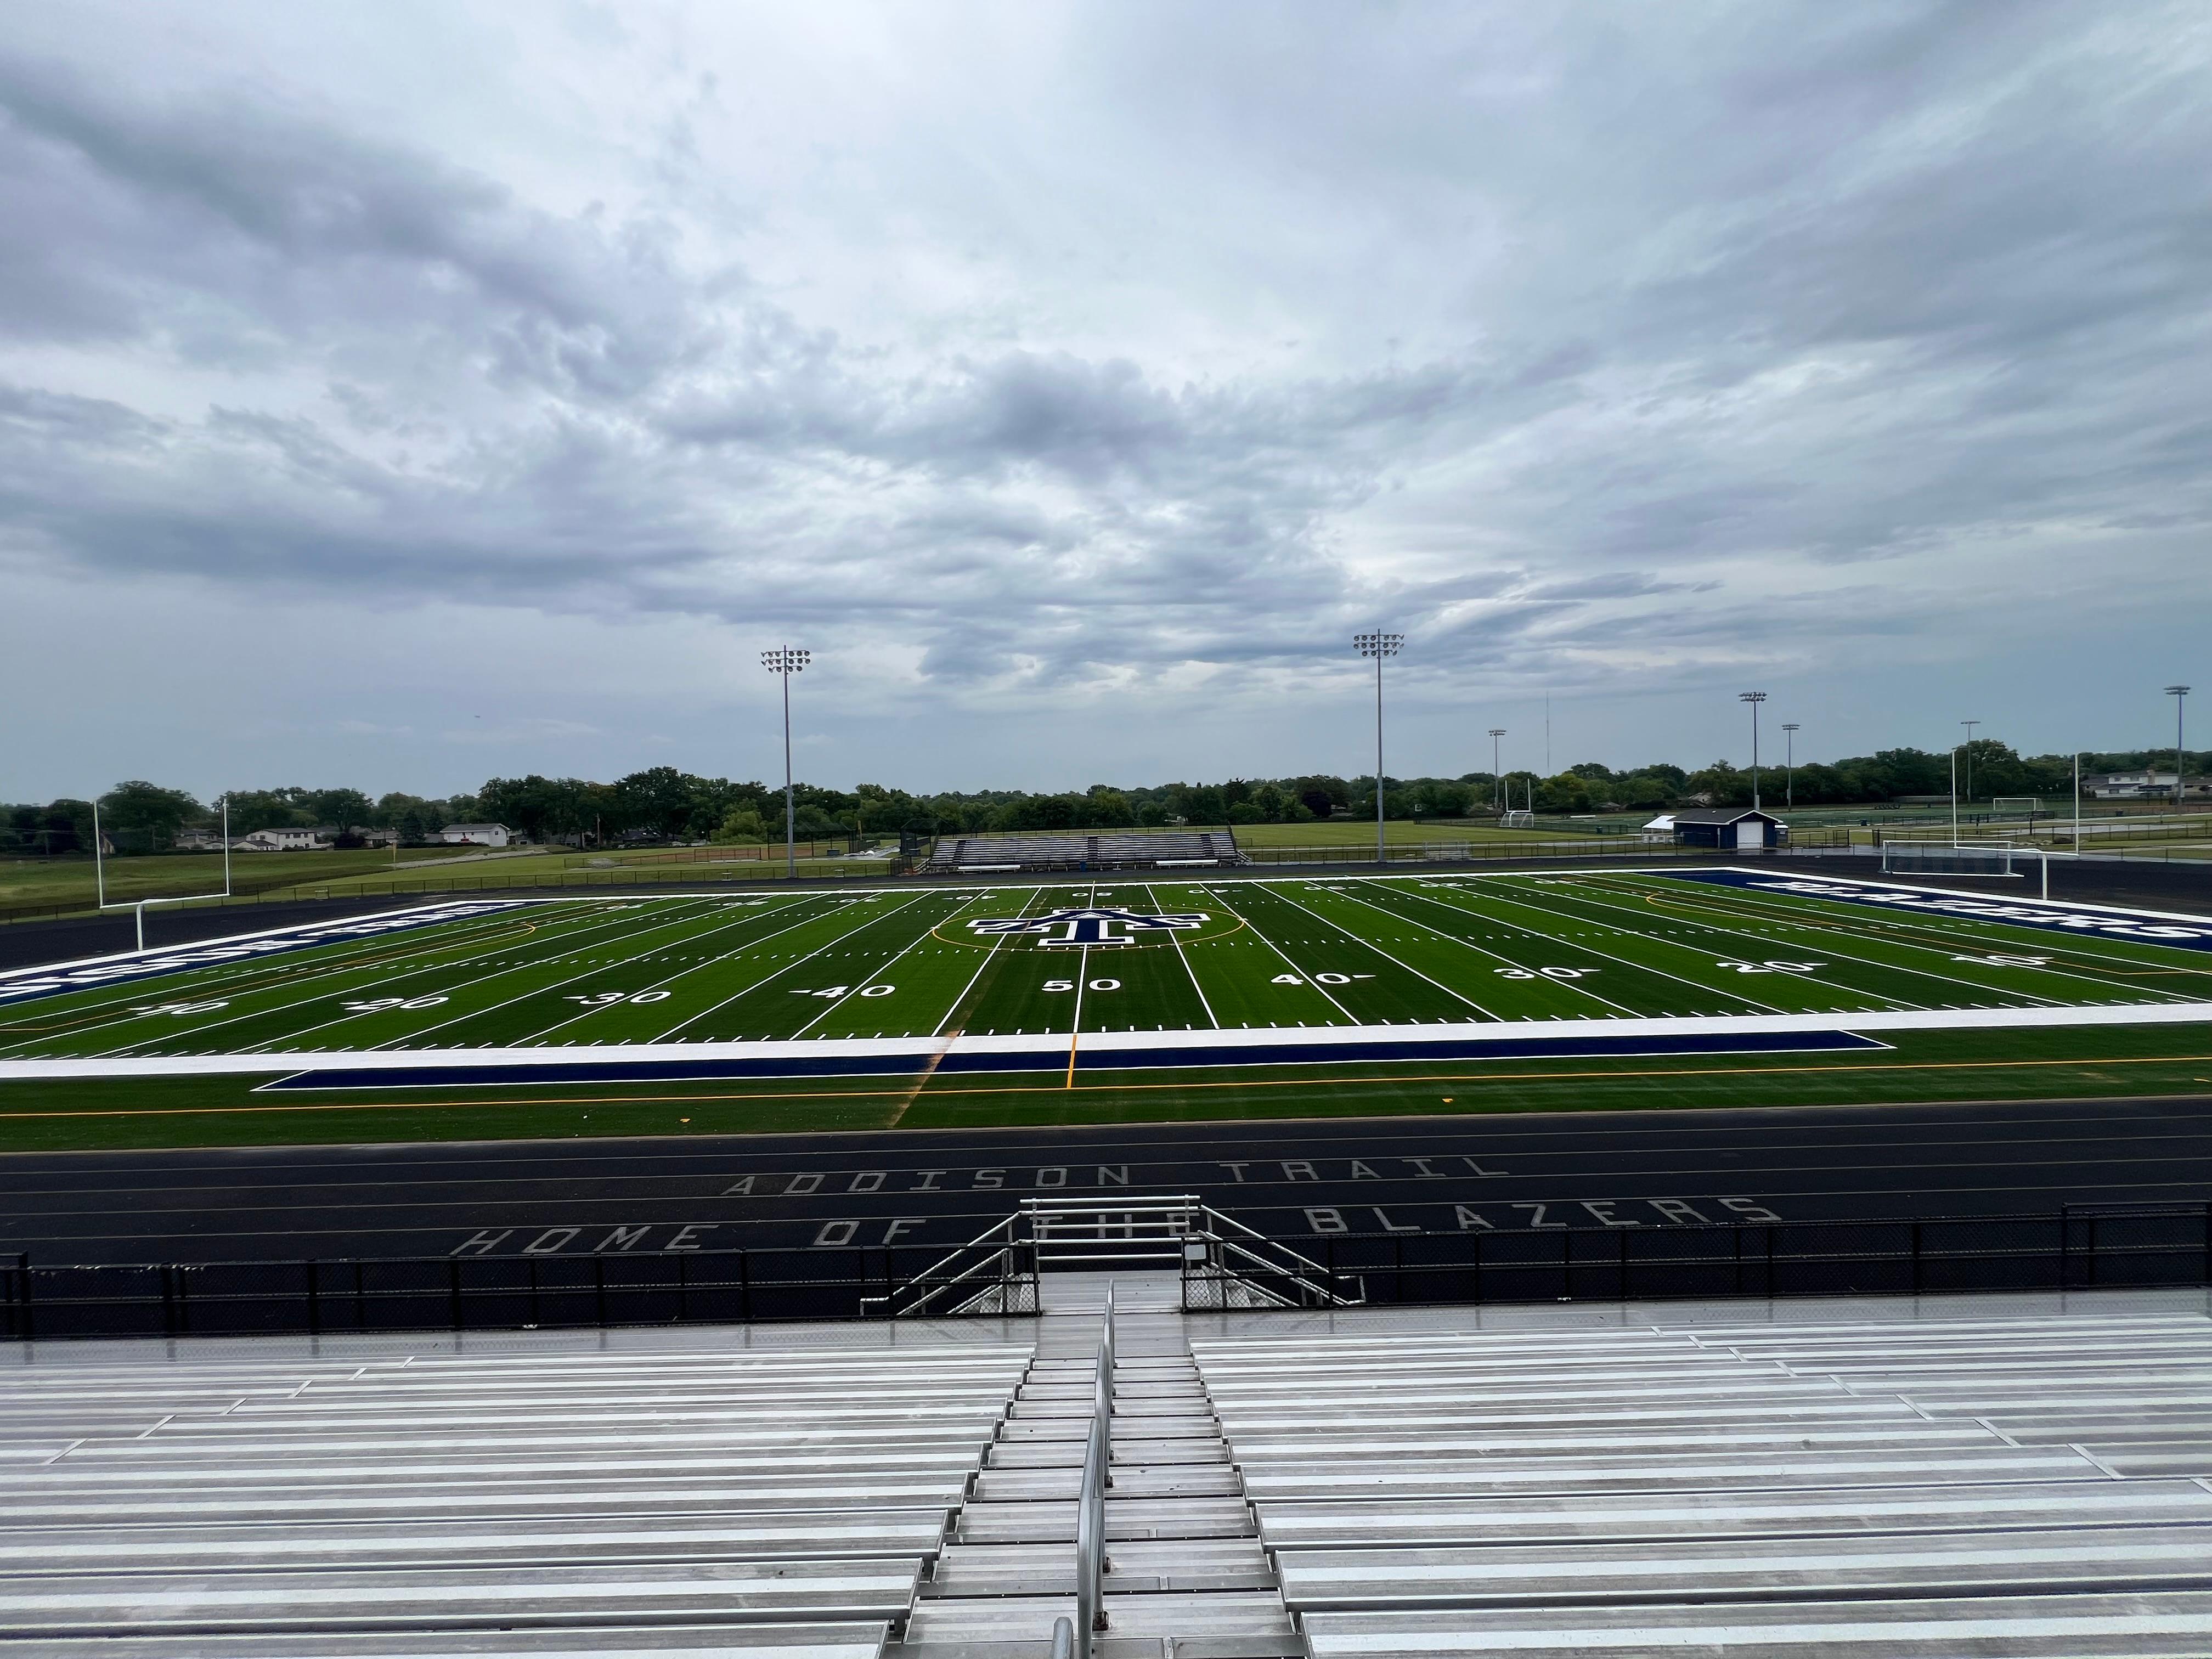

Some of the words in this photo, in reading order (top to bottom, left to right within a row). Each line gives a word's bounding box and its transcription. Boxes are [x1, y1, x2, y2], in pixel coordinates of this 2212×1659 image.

[1746, 882, 2212, 938] BLAZERS
[1493, 967, 1583, 979] 30
[1716, 962, 1814, 973] 20
[1041, 979, 1121, 992] 50
[1271, 973, 1351, 985] 40
[579, 991, 672, 1005] 30
[811, 985, 895, 998] 40
[344, 997, 449, 1010] 20
[721, 1166, 1129, 1196] ADDISON
[1218, 1158, 1509, 1182] TRAIL
[450, 1224, 719, 1256] HOME
[812, 1219, 926, 1246] OF
[1304, 1198, 1782, 1233] BLAZERS
